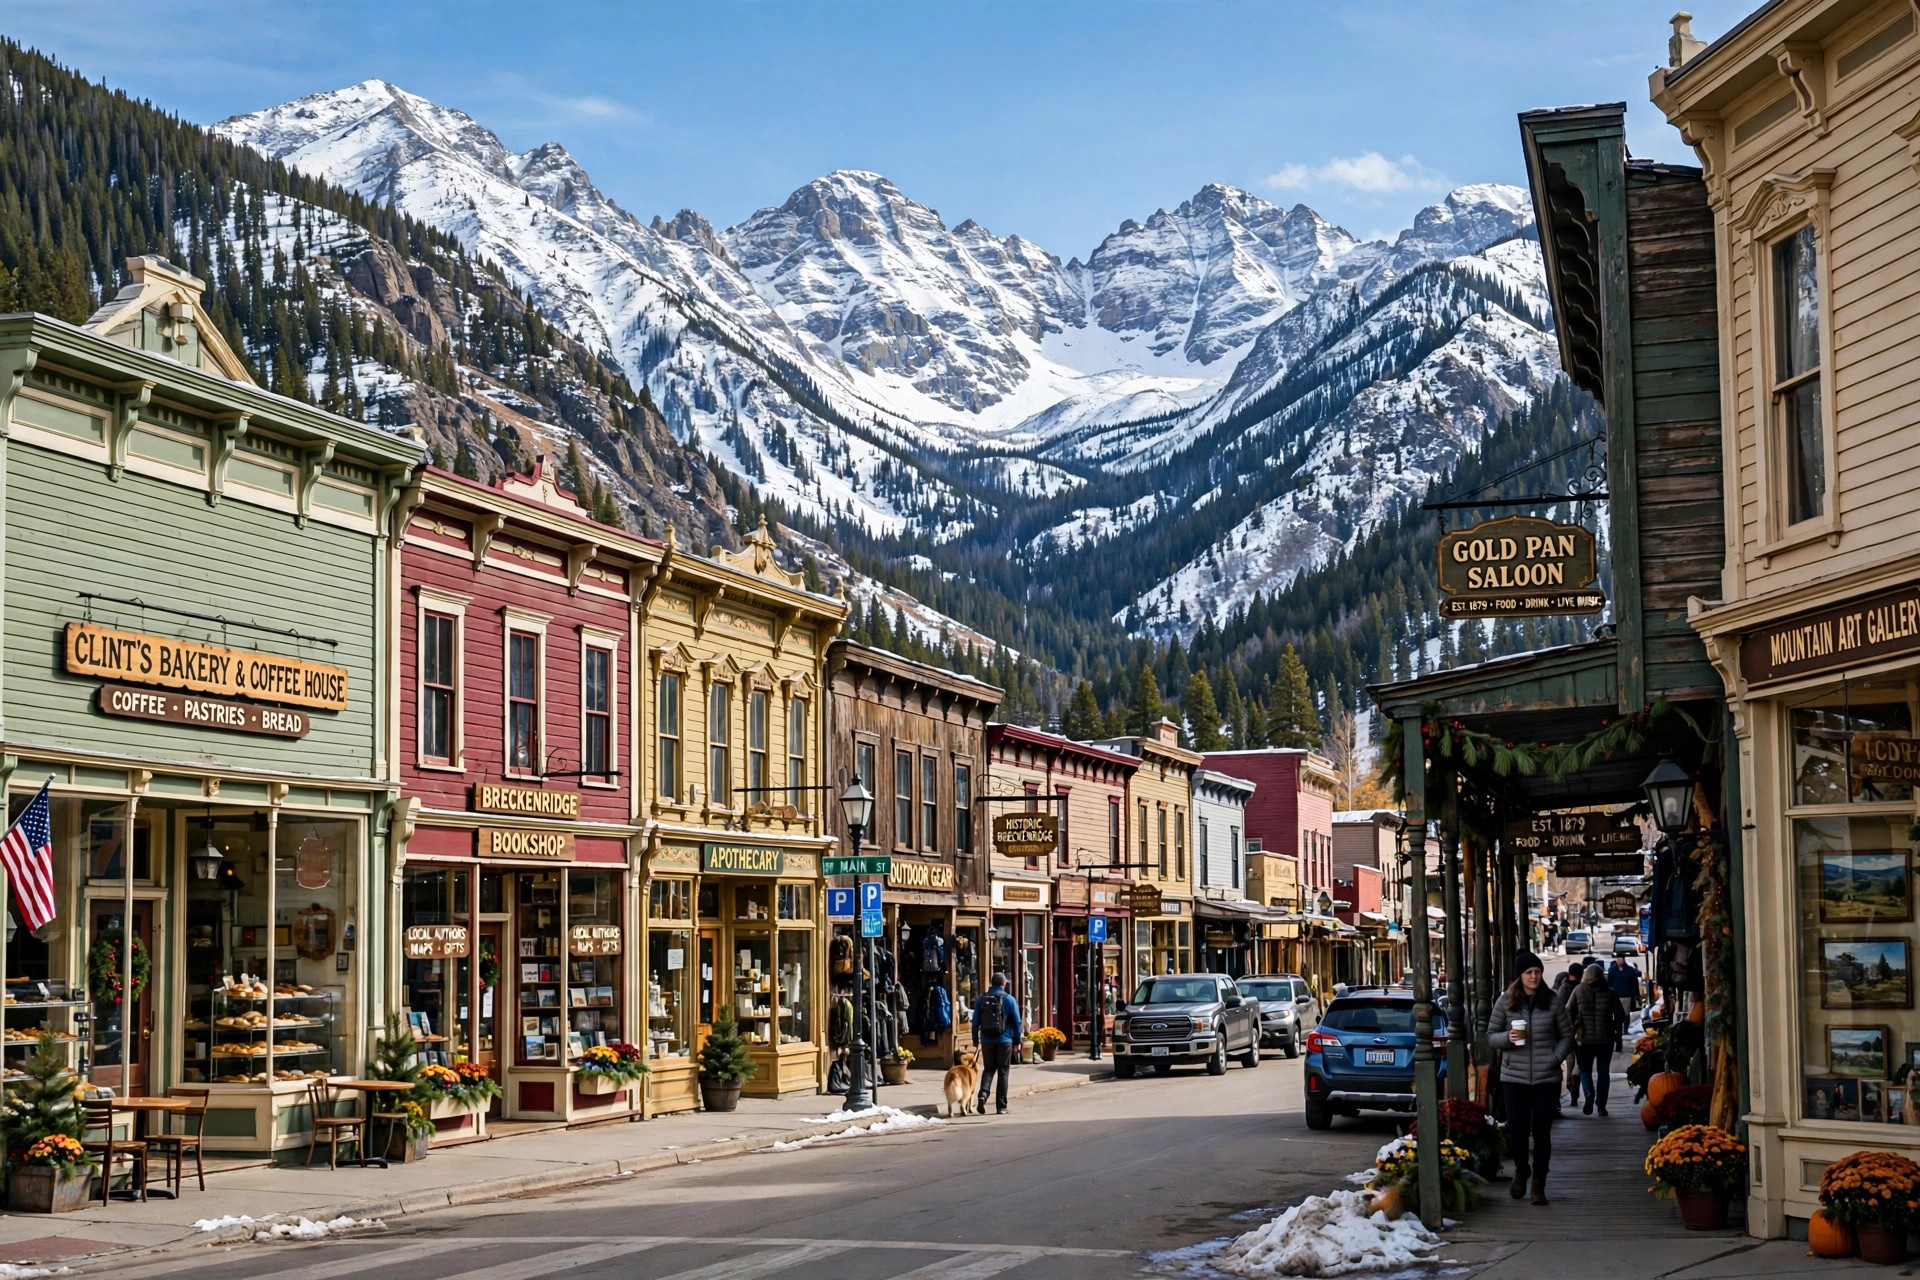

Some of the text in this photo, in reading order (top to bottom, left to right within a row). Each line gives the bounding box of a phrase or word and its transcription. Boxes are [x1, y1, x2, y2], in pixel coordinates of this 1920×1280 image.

[1453, 535, 1575, 563] GOLD PAN
[1468, 563, 1564, 589] SALOON
[1470, 600, 1488, 611] 1879
[1495, 599, 1517, 610] FOOD
[1525, 597, 1550, 609] DRINK
[1557, 597, 1575, 608] LIVE
[1770, 621, 1833, 666] MOUNTAIN
[1838, 613, 1862, 652] ART
[75, 631, 345, 702] CLINT'S BAKERY & COFFEE HOUSE
[112, 690, 302, 733] COFFEE PASTRIES BREAD
[482, 786, 578, 815] BRECKENRIDGE
[1006, 818, 1043, 830] HISTORIC
[1561, 816, 1585, 833] 1879
[492, 831, 566, 856] BOOKSHOP
[1516, 837, 1541, 848] FOOD
[710, 846, 779, 871] APOTHECARY
[840, 860, 867, 873] MAIN
[876, 862, 886, 872] ST
[890, 862, 953, 889] OUTDOOR GEAR
[835, 891, 847, 912] P
[867, 886, 878, 908] P
[1094, 919, 1104, 934] P
